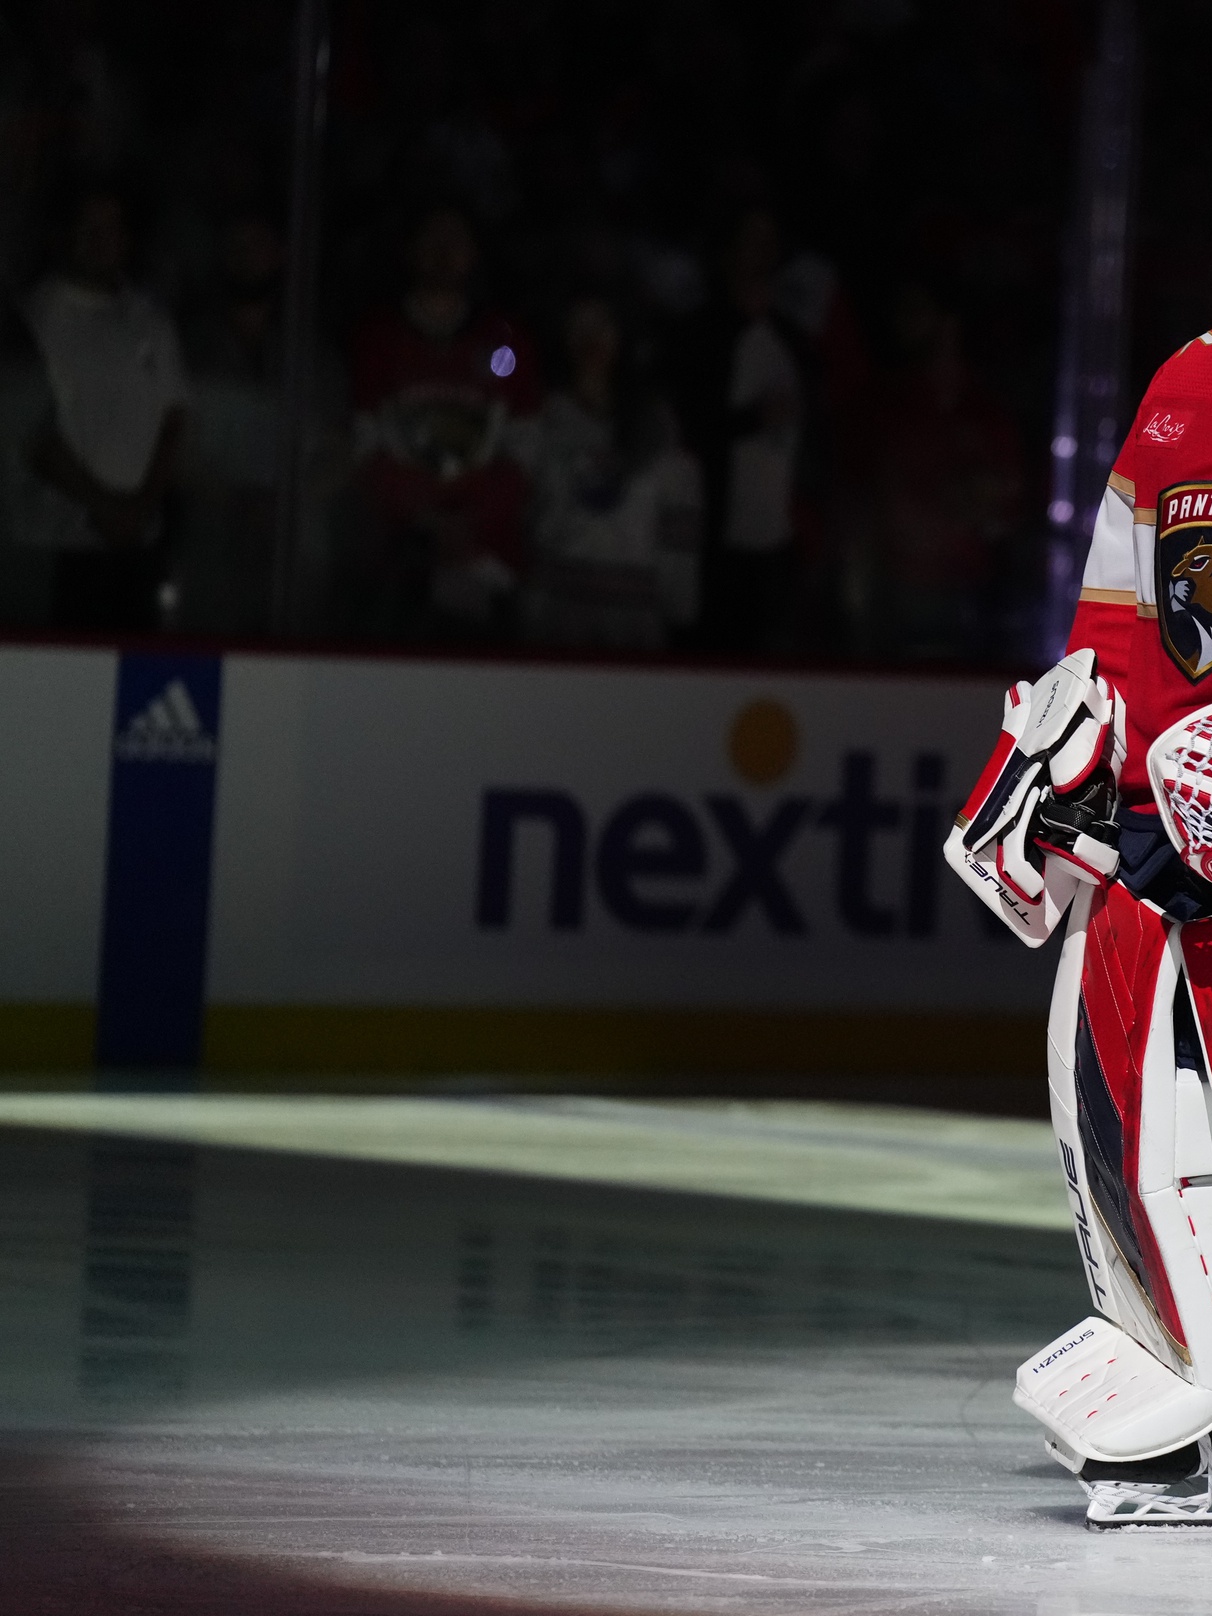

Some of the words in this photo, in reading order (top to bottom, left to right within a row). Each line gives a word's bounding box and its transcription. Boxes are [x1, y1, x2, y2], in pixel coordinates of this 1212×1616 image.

[476, 747, 1025, 942] nexti
[969, 861, 1031, 925] TRUE
[1059, 1138, 1104, 1310] TRUE
[1032, 1328, 1095, 1374] HZRDUS
